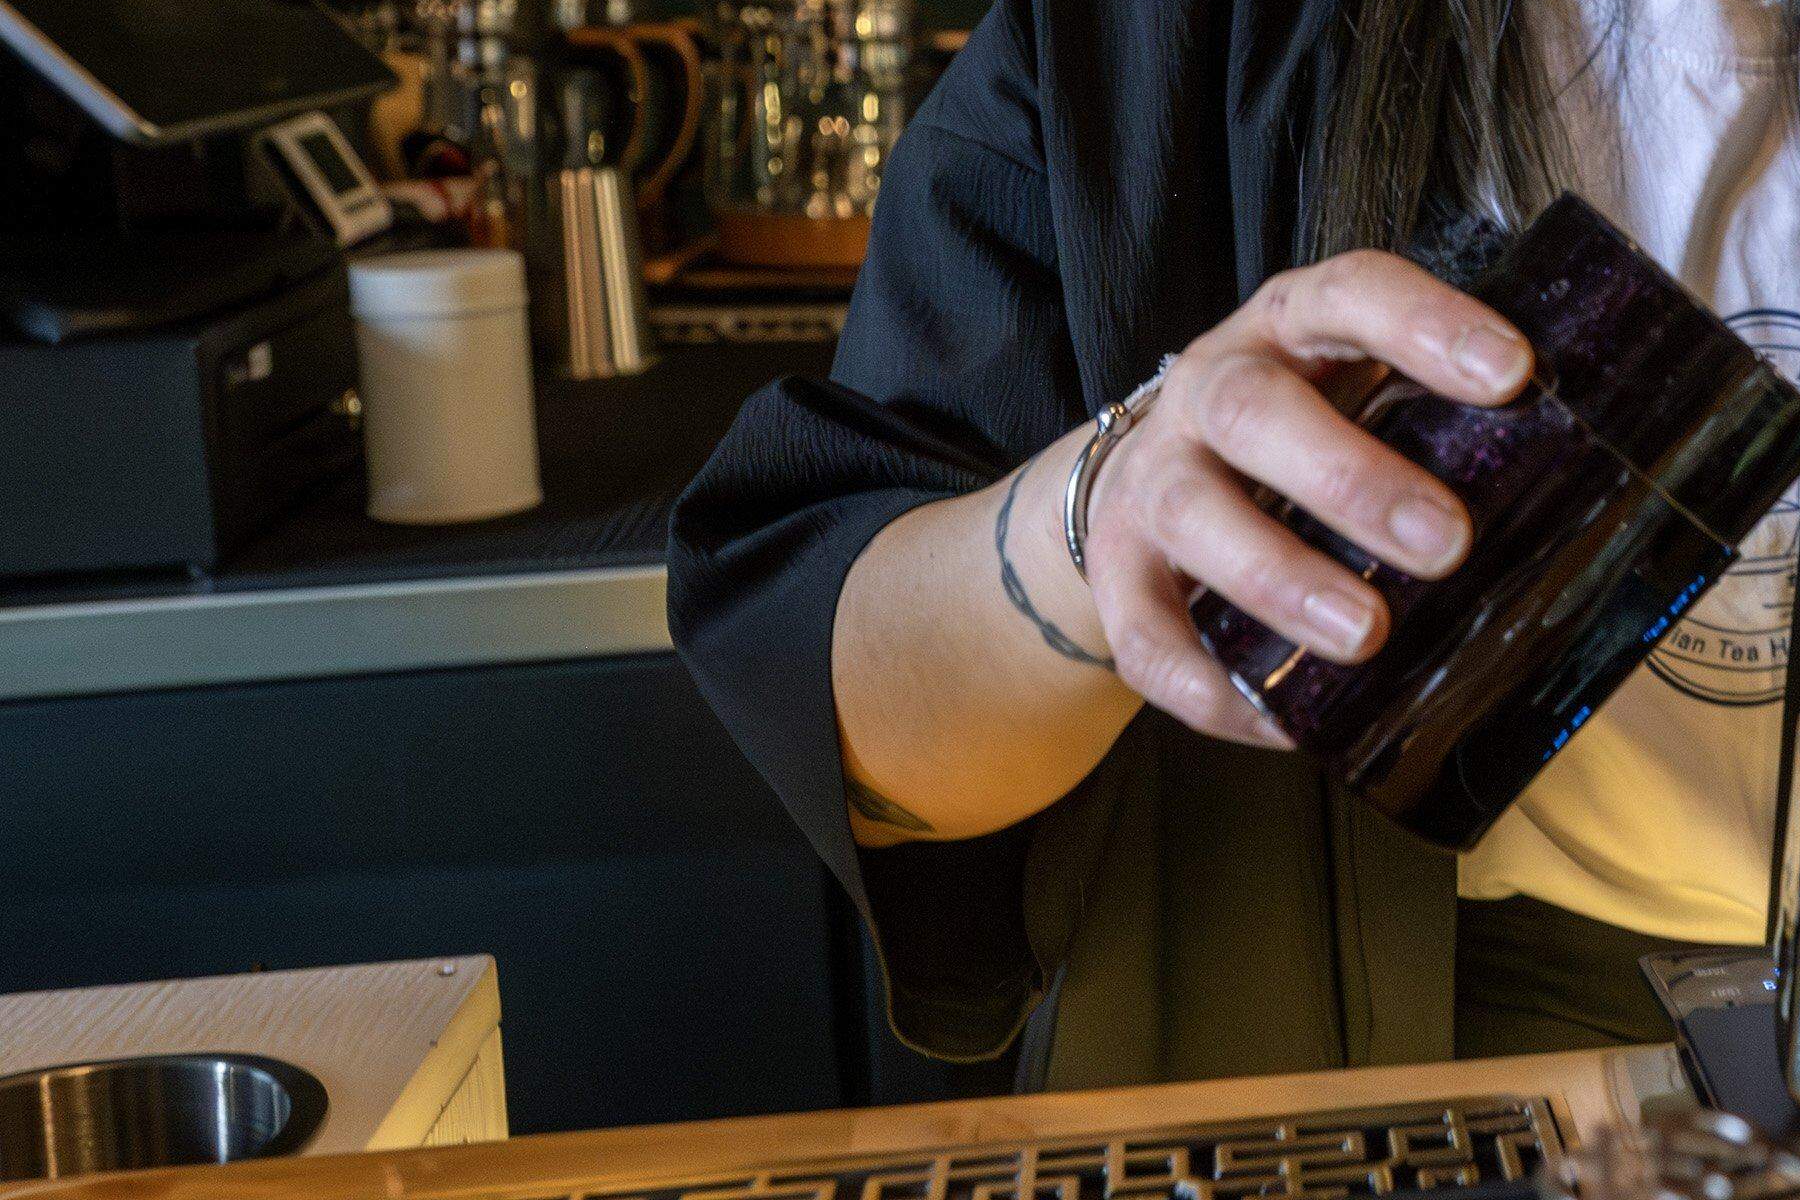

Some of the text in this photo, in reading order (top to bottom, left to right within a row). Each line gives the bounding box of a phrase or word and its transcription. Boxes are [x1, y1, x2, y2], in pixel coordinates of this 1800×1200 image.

[1669, 625, 1706, 654] ian
[1718, 638, 1759, 661] Tea
[1769, 636, 1790, 659] H
